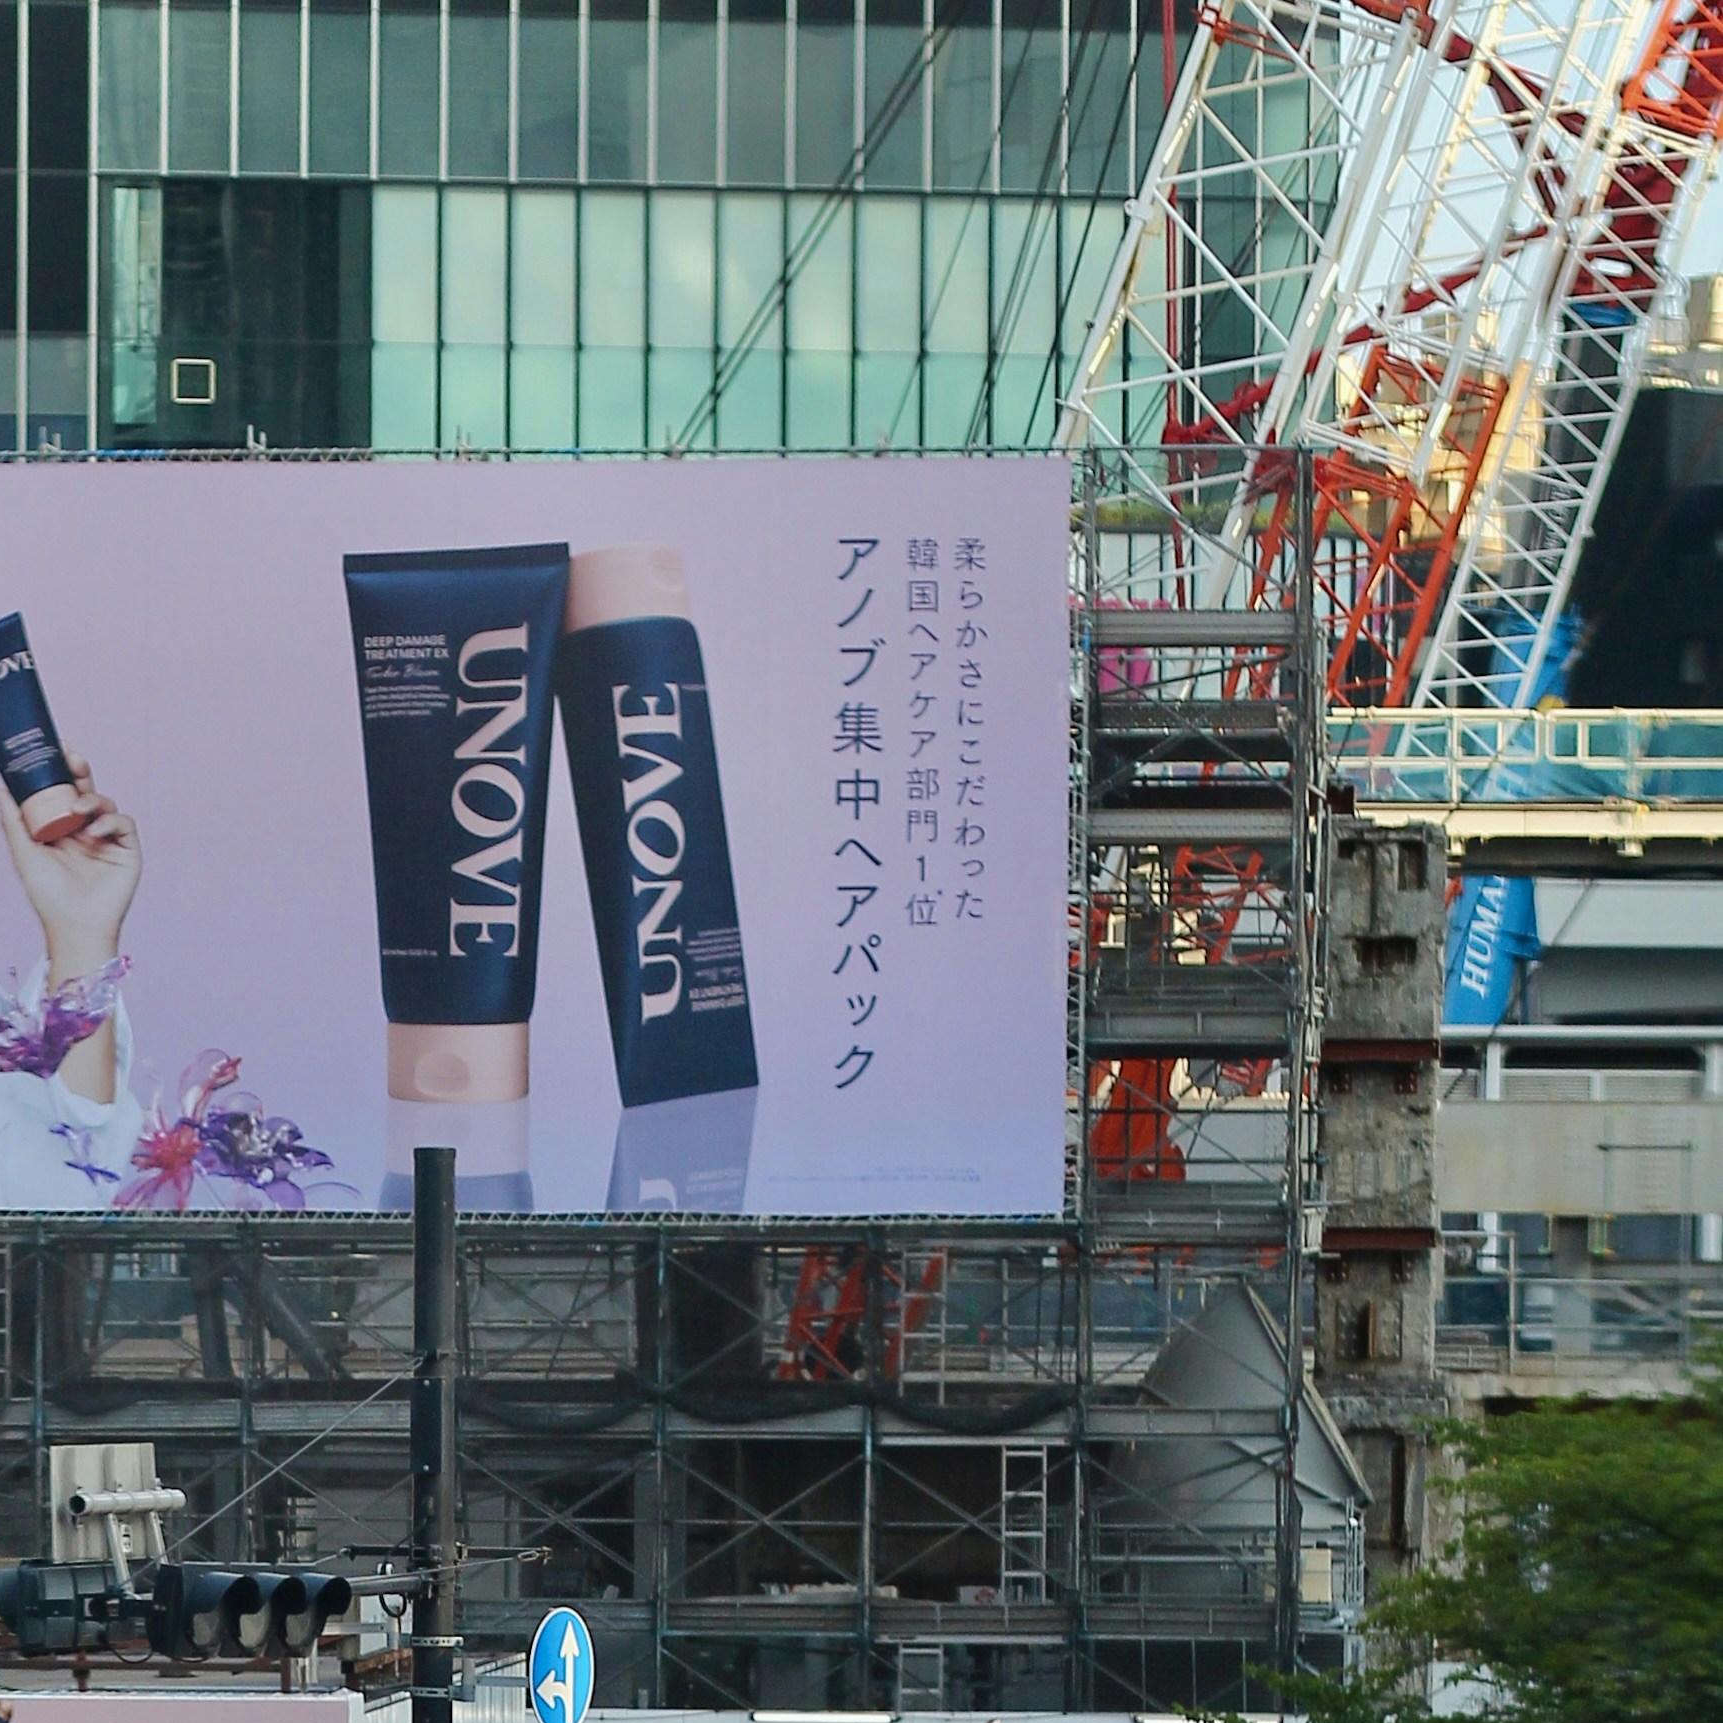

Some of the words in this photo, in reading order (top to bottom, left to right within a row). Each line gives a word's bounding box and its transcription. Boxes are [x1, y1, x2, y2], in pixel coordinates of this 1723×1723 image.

[363, 636, 394, 648] DEEP
[395, 634, 446, 647] DAMAGE
[364, 648, 432, 660] TREATMENT
[433, 647, 449, 659] EX
[449, 621, 529, 957] UNOVE
[953, 537, 989, 919] 柔らかさにこだわった
[612, 682, 686, 1026] UNOVE
[831, 537, 888, 1090] アノブ集中ヘアパック
